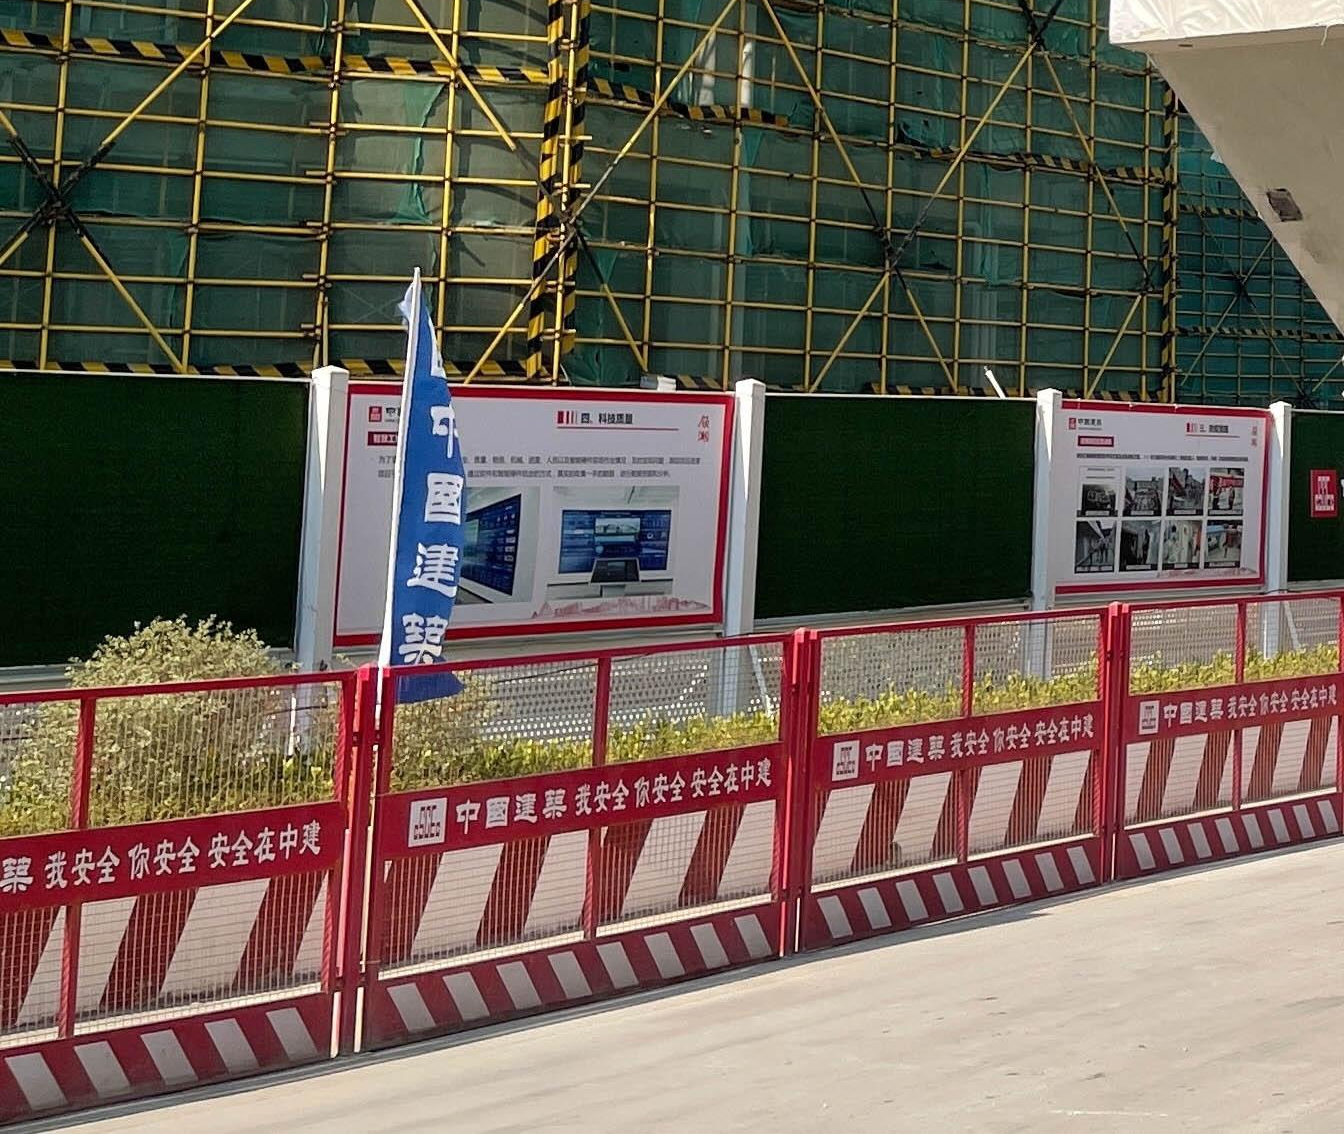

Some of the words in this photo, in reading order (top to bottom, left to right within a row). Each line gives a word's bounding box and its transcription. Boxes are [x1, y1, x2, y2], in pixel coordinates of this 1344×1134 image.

[865, 735, 946, 772] 中國建築
[950, 727, 990, 759] 我安全
[1034, 714, 1094, 747] 安全在中建
[455, 788, 568, 835] 中國建築
[574, 779, 630, 816] 我安全
[633, 771, 686, 807] 你安全
[690, 757, 772, 798] 安全在中建
[44, 845, 120, 890] 我安全
[128, 836, 200, 881] 你安全
[208, 819, 322, 869] 安全在中建
